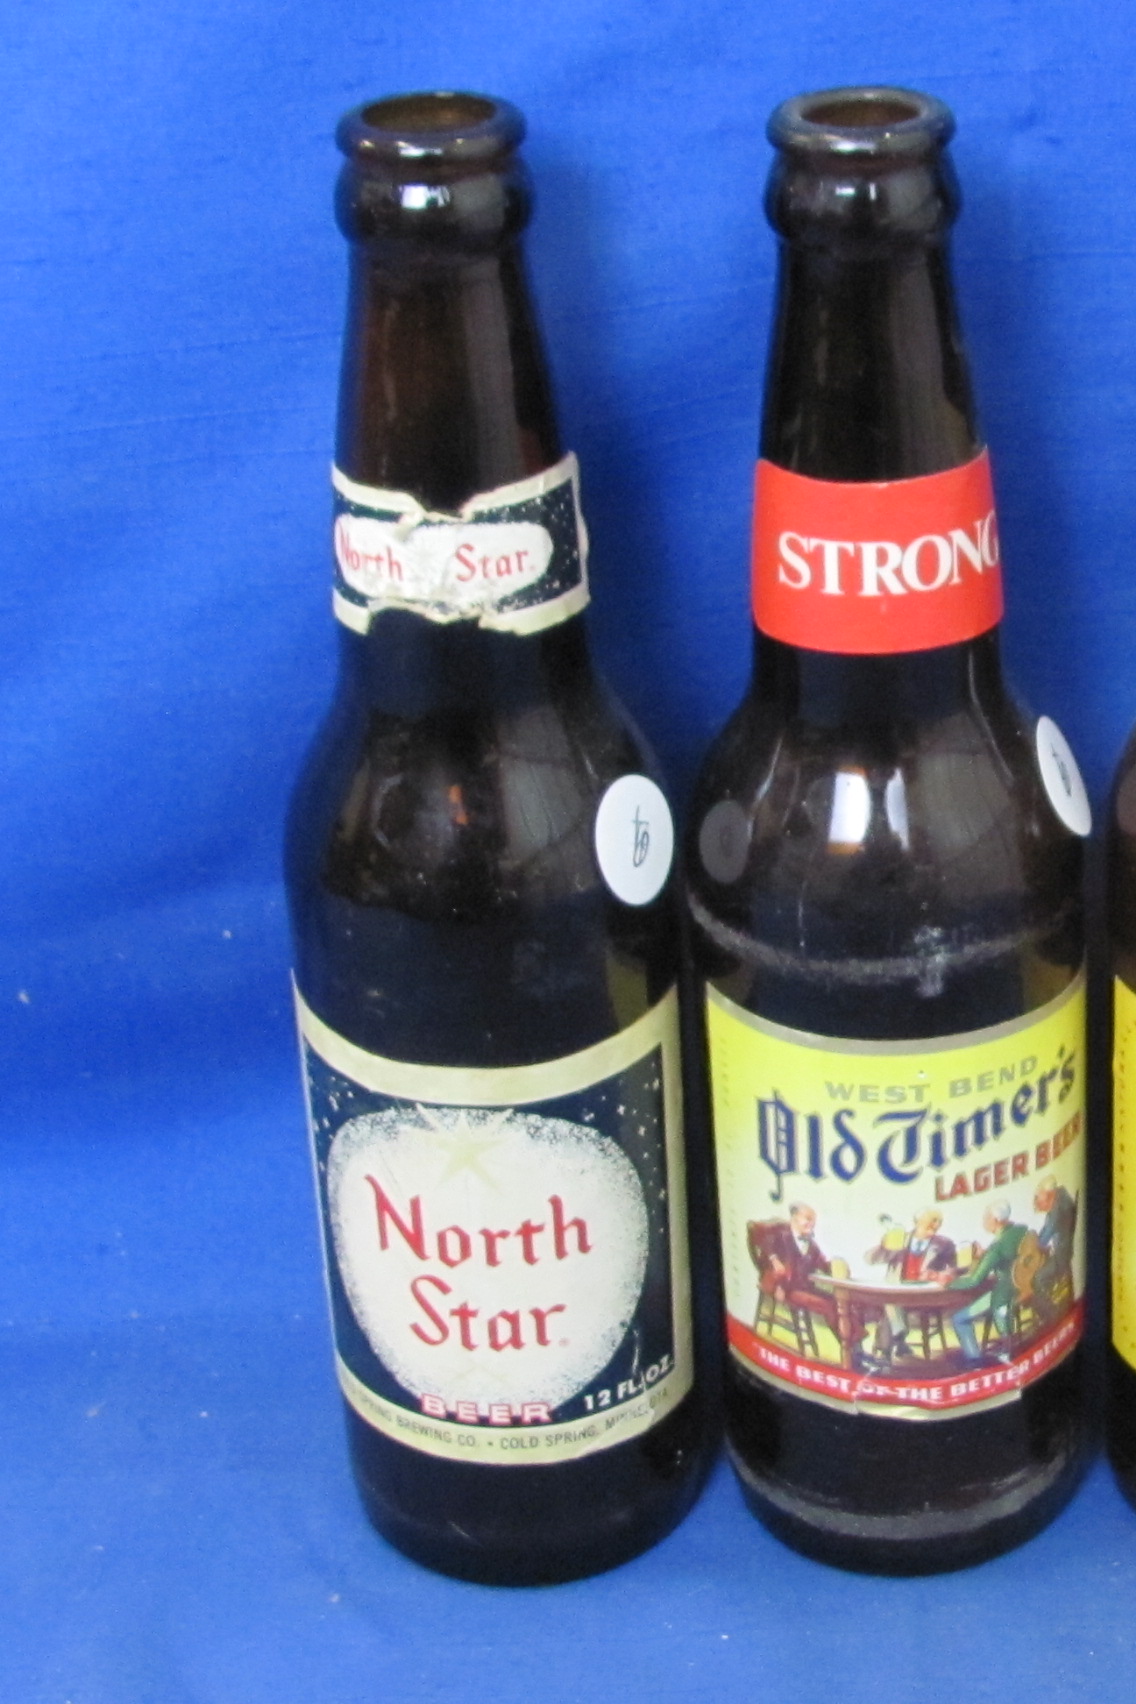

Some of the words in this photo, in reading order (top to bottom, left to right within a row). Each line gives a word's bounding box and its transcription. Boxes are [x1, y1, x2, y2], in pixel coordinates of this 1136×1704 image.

[454, 542, 530, 583] Star
[824, 1080, 932, 1104] WEST
[948, 1055, 1039, 1099] BEND
[755, 1087, 867, 1203] Old
[872, 1044, 1076, 1187] Timer's
[934, 1150, 1030, 1203] LAGER
[364, 1173, 594, 1269] North
[409, 1274, 567, 1353] Star
[584, 1388, 612, 1411] 12
[795, 1364, 851, 1393] BEST
[896, 1385, 943, 1401] THE
[950, 1359, 1031, 1398] BETTER
[420, 1392, 552, 1426] BEER
[396, 1414, 453, 1444] BREWING
[500, 1435, 540, 1451] COLD
